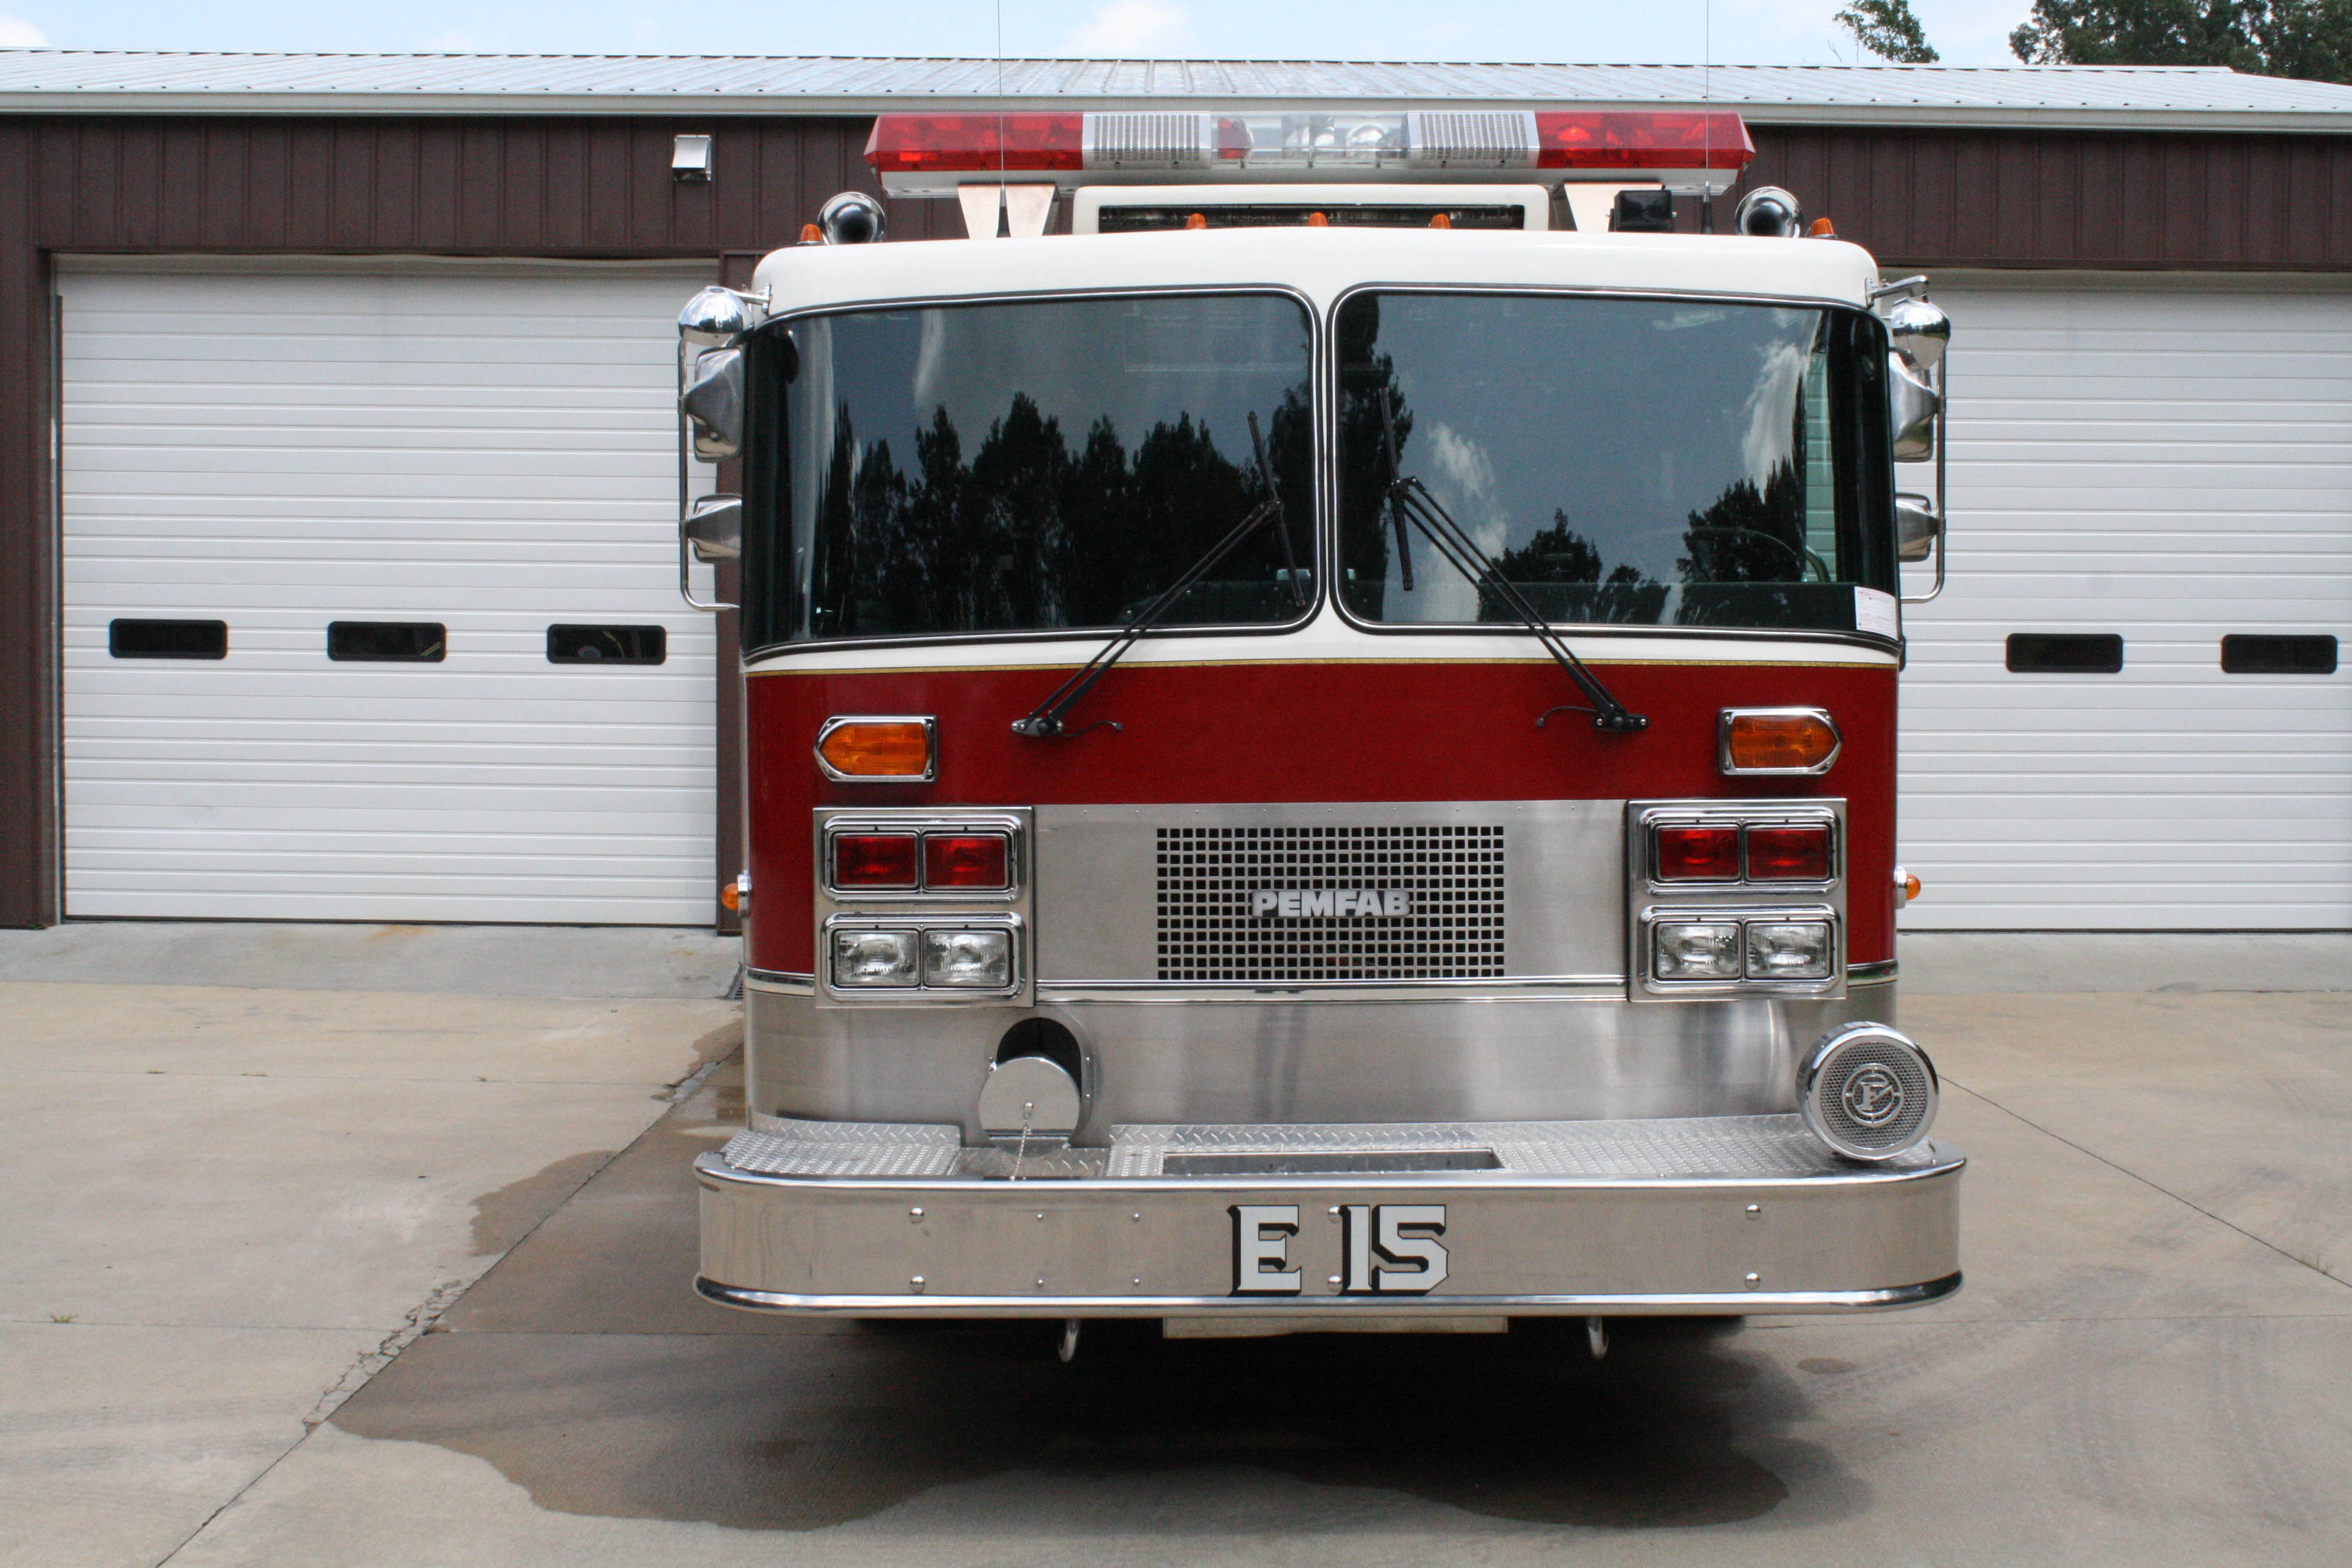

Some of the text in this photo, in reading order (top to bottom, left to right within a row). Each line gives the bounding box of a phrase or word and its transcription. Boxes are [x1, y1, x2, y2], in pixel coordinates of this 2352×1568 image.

[1252, 890, 1410, 917] PEMFAB
[1227, 1204, 1449, 1296] E 15
